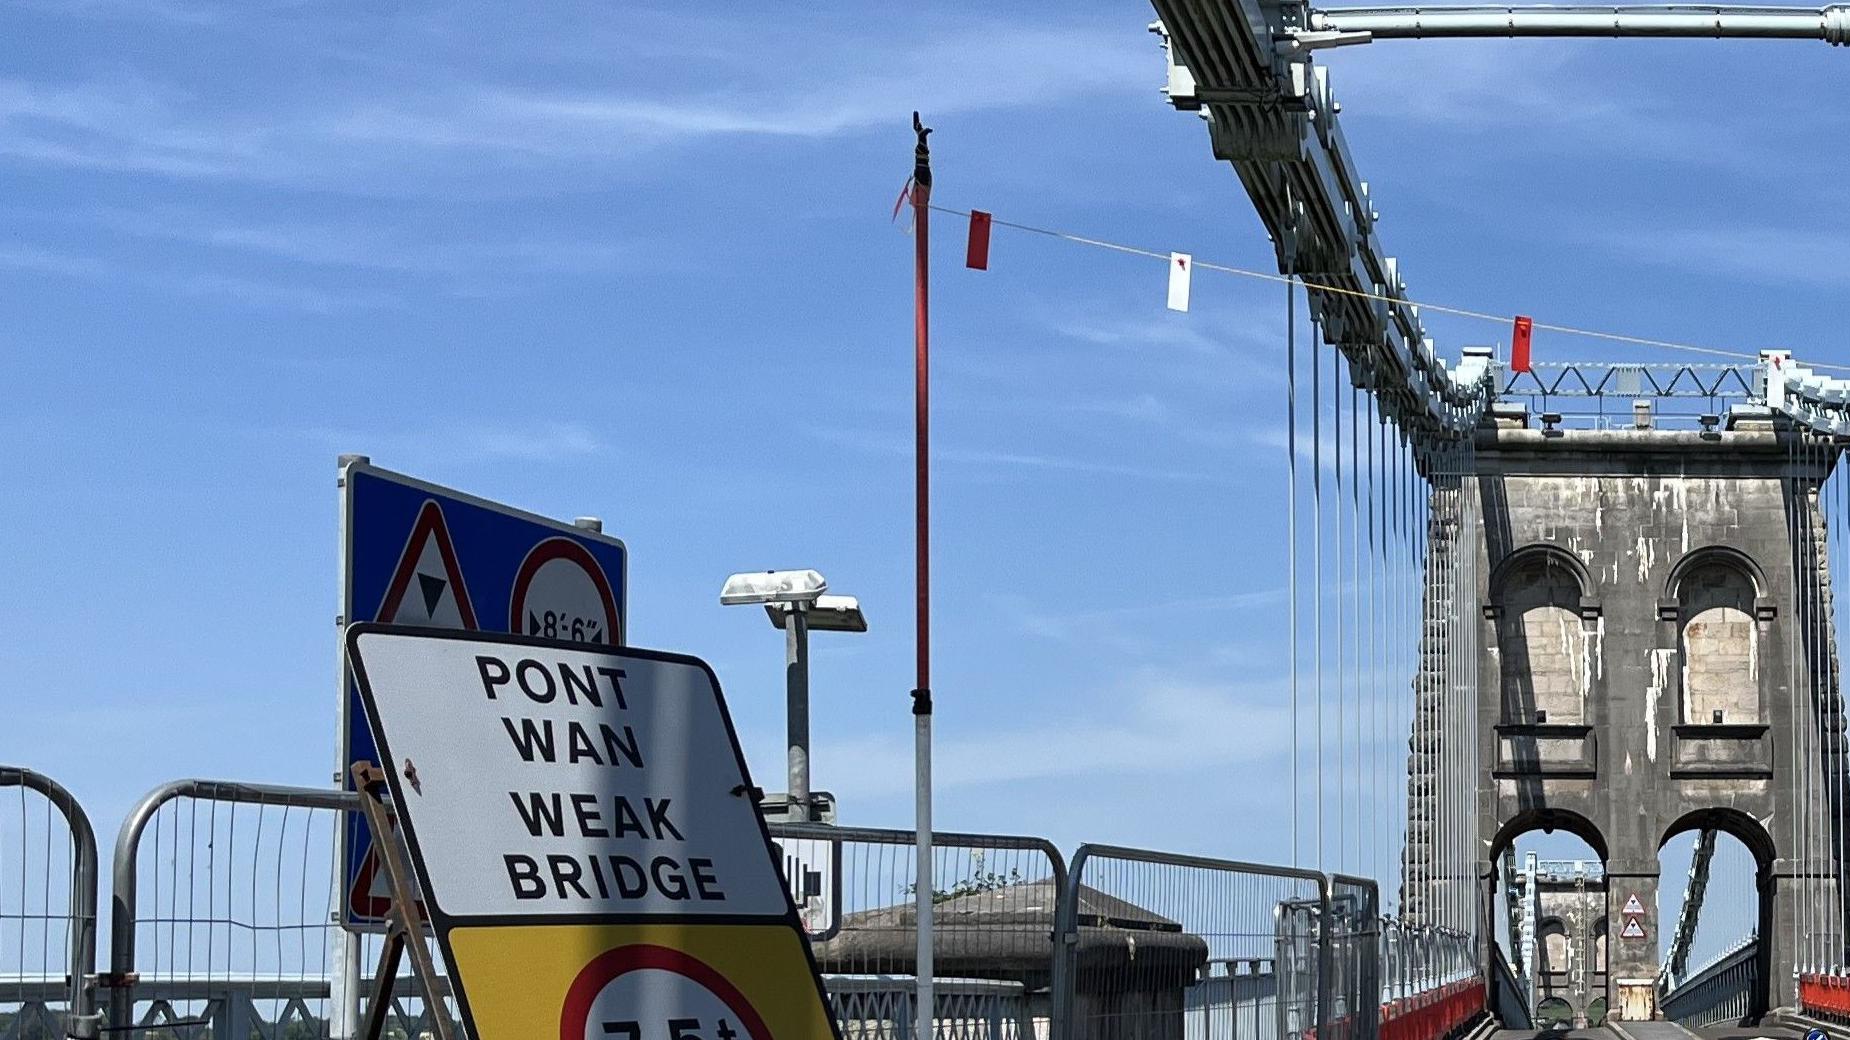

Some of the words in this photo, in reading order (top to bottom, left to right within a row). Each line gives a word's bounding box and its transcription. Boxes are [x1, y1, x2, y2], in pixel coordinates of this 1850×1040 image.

[475, 656, 627, 710] PONT
[501, 716, 644, 769] WAN
[508, 791, 685, 841] WEAK
[502, 854, 726, 901] BRIDGE
